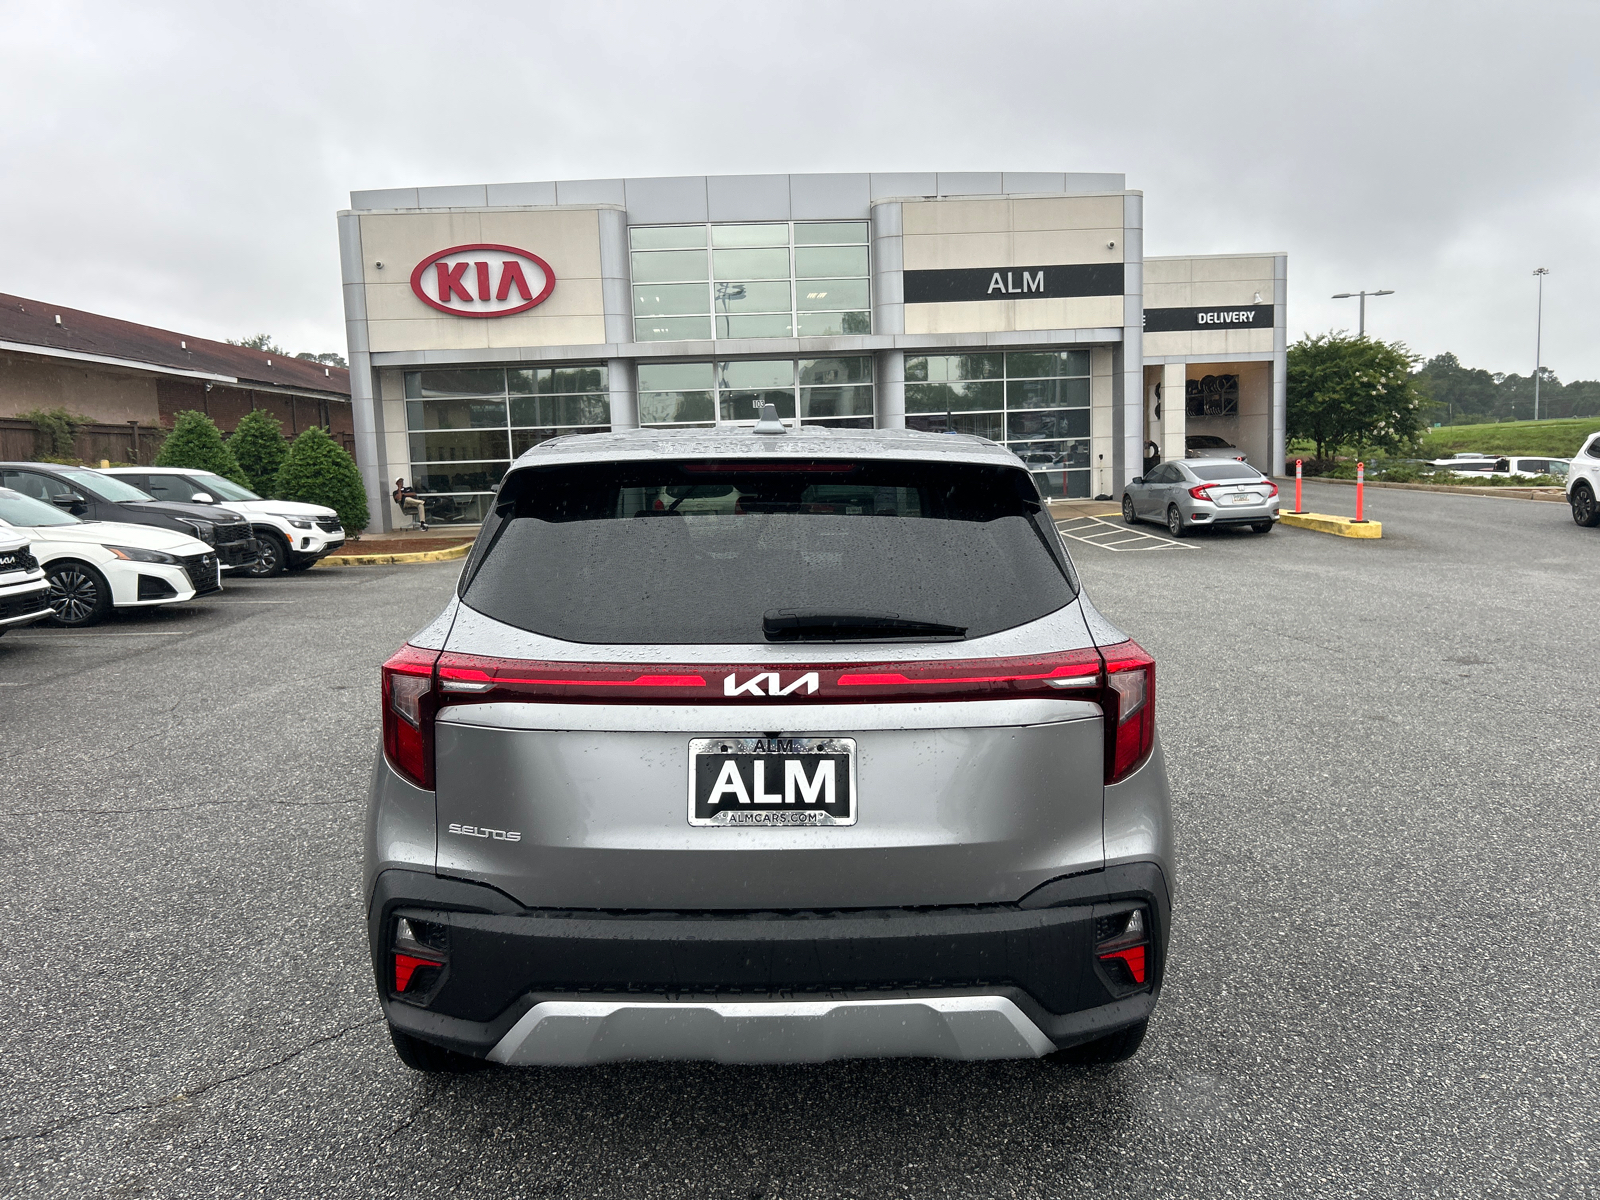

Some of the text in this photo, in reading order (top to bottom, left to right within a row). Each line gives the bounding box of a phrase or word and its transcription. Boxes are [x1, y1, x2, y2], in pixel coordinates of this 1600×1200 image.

[434, 261, 533, 302] KIA
[987, 270, 1044, 294] ALM
[1198, 311, 1255, 324] DELIVERY
[724, 672, 819, 696] KIA
[753, 739, 793, 752] ALM
[707, 760, 836, 803] ALM
[729, 813, 817, 823] ALMCARS.COM
[448, 823, 522, 842] SELTOS
